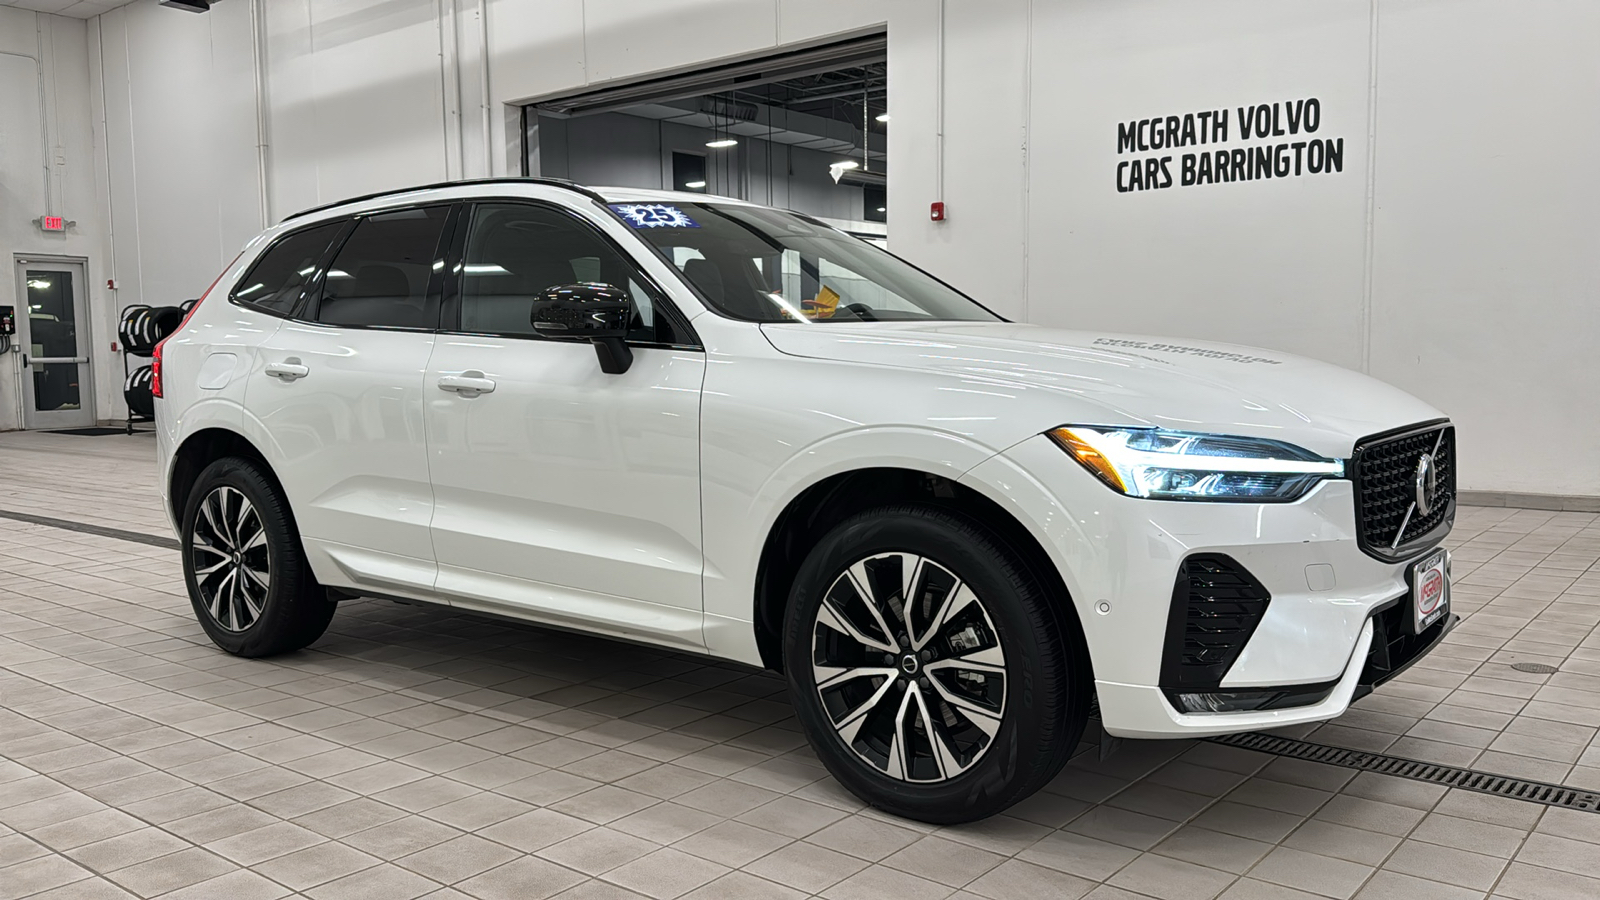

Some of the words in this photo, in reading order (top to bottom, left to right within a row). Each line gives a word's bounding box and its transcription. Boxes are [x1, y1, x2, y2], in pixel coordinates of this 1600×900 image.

[1117, 108, 1229, 155] MCGRATH
[1237, 97, 1321, 141] VOLVO
[1116, 155, 1173, 193] CARS
[1180, 137, 1344, 187] BARRINGTON
[45, 216, 62, 230] EXIT
[635, 208, 676, 223] 25
